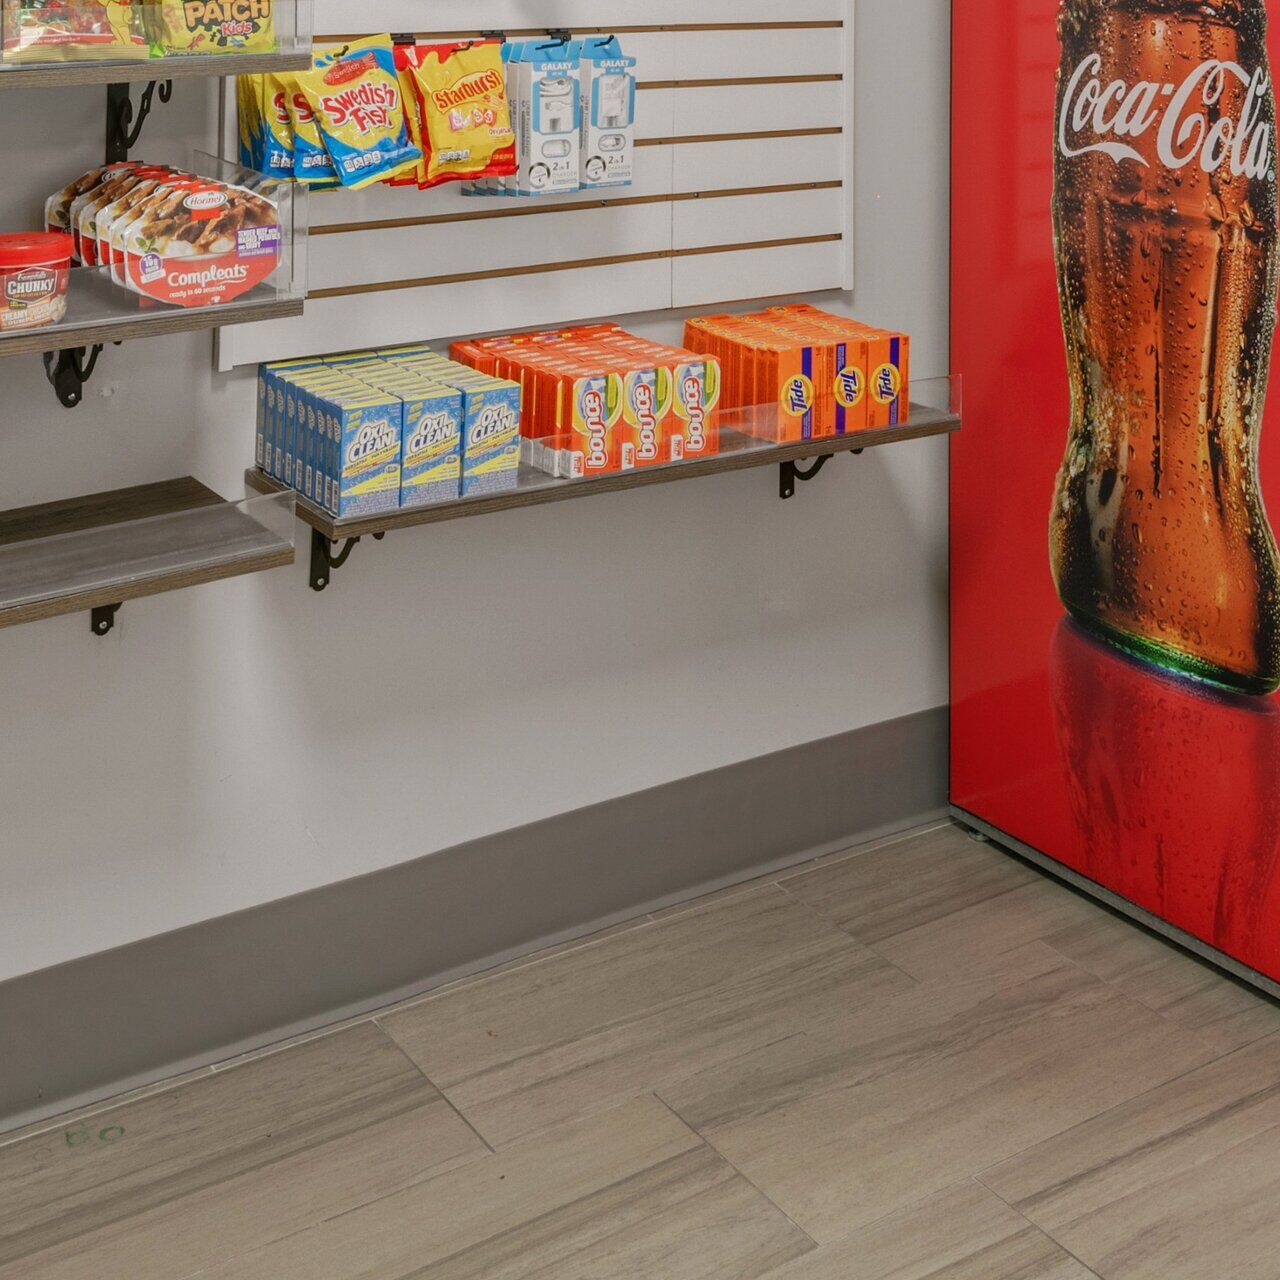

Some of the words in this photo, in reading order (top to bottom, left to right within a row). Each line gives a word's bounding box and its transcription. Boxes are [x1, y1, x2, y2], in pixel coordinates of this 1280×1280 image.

[221, 20, 253, 36] Kids
[540, 61, 573, 72] GALAXY
[599, 58, 630, 69] GALAXY
[321, 82, 398, 124] Swedish
[432, 69, 504, 111] Starburst
[349, 107, 394, 135] Fish
[1058, 53, 1273, 180] Coca-Cola
[7, 278, 55, 295] CHUNKY
[167, 264, 248, 288] Compleats
[789, 378, 808, 414] Tide
[840, 370, 858, 403] Tide
[877, 367, 895, 400] Tide
[420, 415, 446, 434] OXI
[481, 406, 506, 425] OXI
[358, 421, 387, 441] OXI
[410, 425, 454, 452] CLEAN
[471, 415, 513, 444] CLEAN
[349, 432, 395, 462] CLEAN
